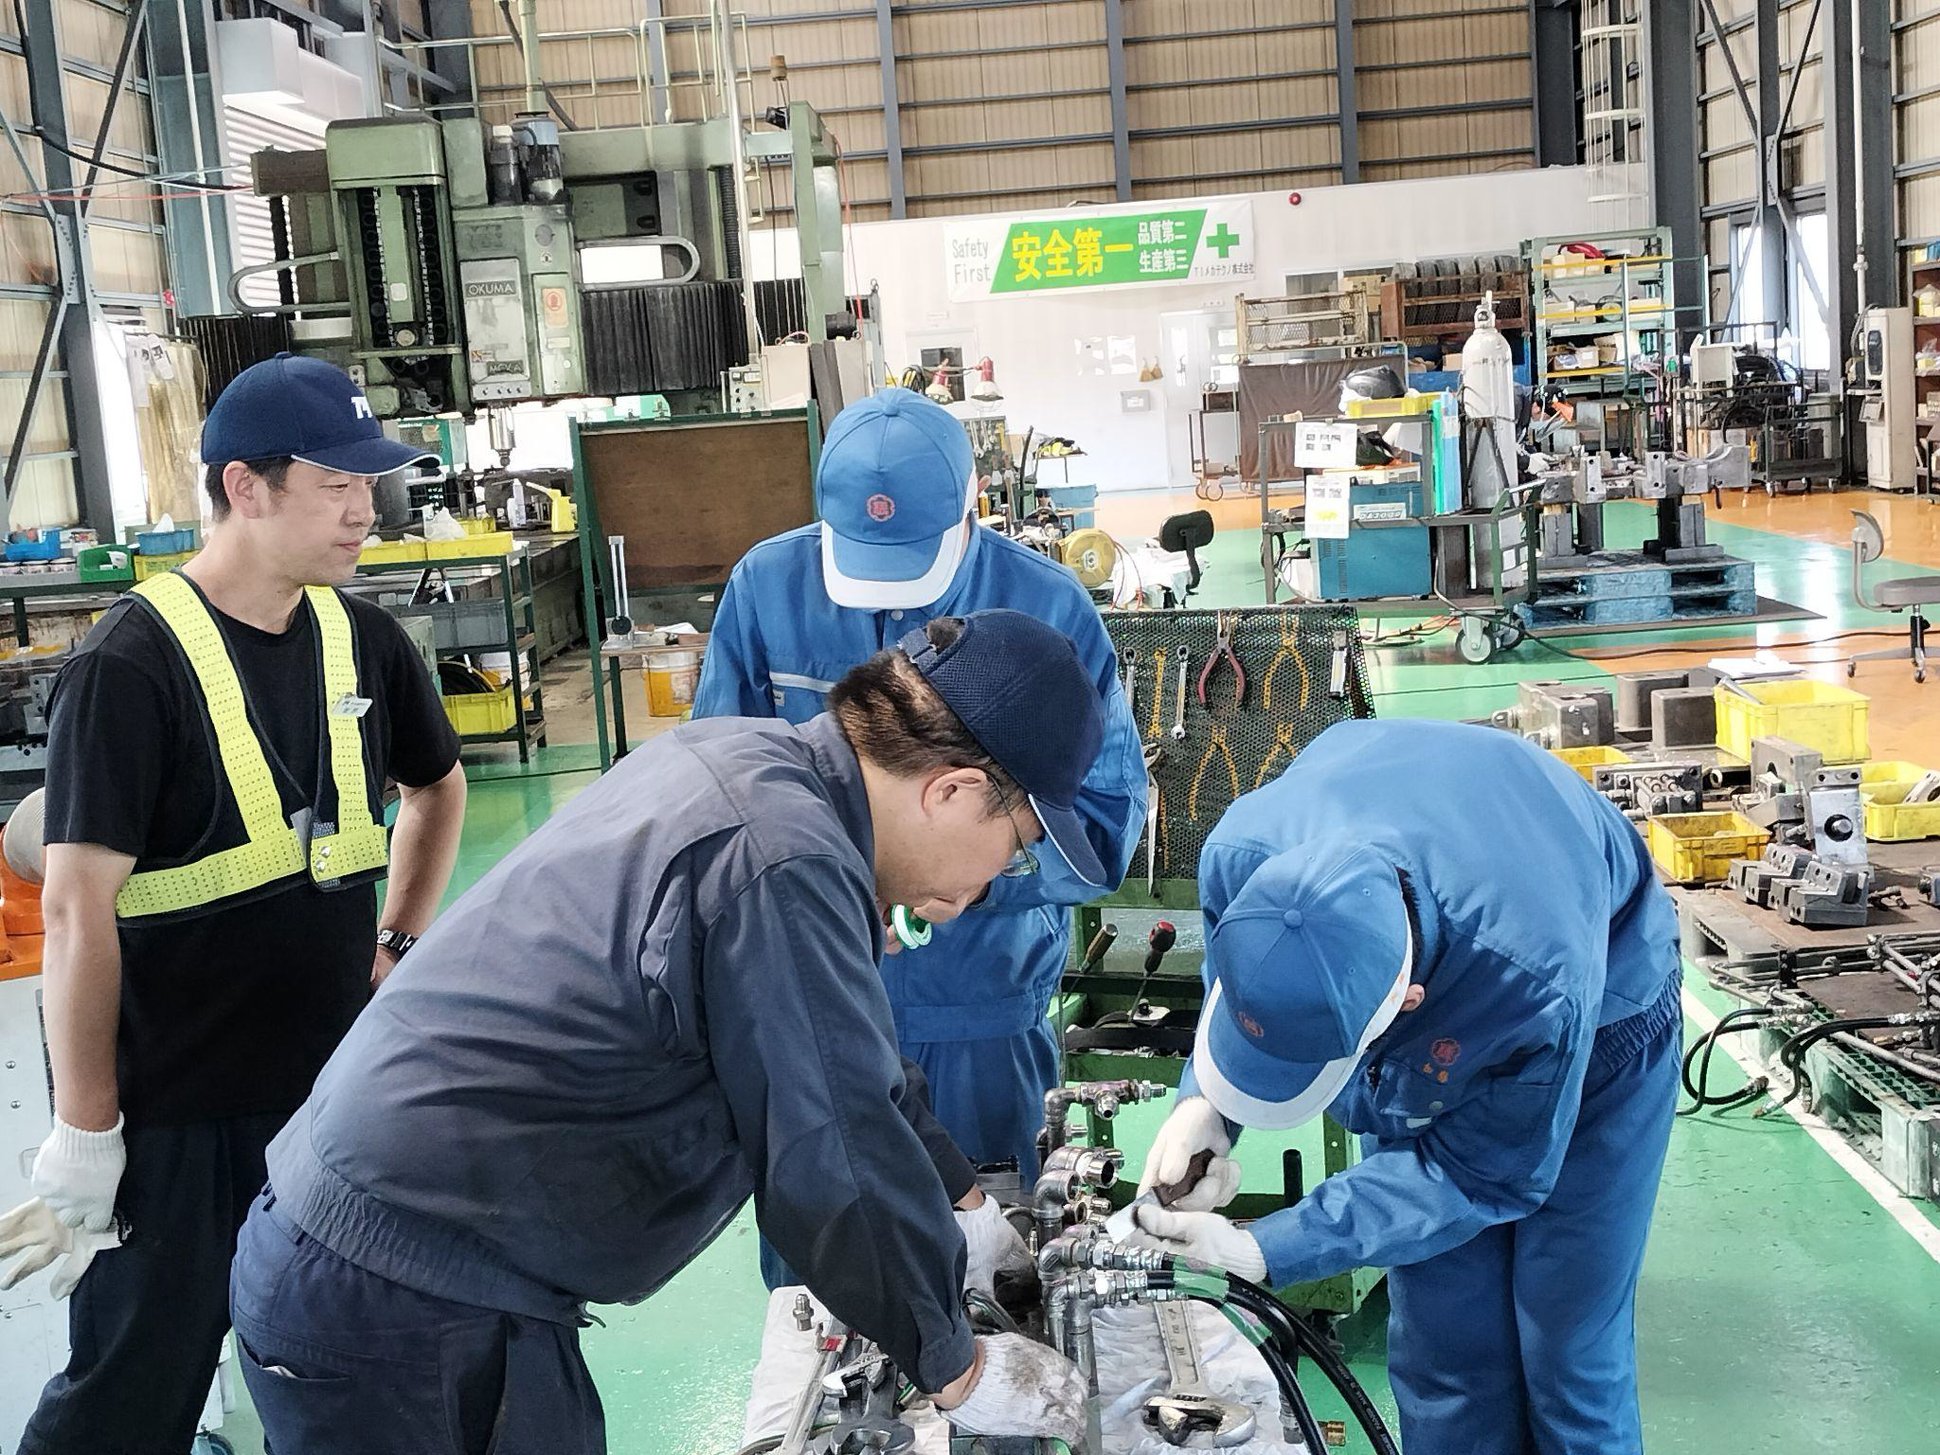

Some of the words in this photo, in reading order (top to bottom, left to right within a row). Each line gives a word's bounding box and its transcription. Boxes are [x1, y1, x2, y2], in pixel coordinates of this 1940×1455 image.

[1137, 219, 1187, 246] 品質第二
[952, 237, 989, 260] Safety
[1011, 226, 1134, 282] 安全第一
[1138, 248, 1189, 273] 生産第三
[954, 263, 991, 284] First
[468, 282, 515, 296] OKUMA
